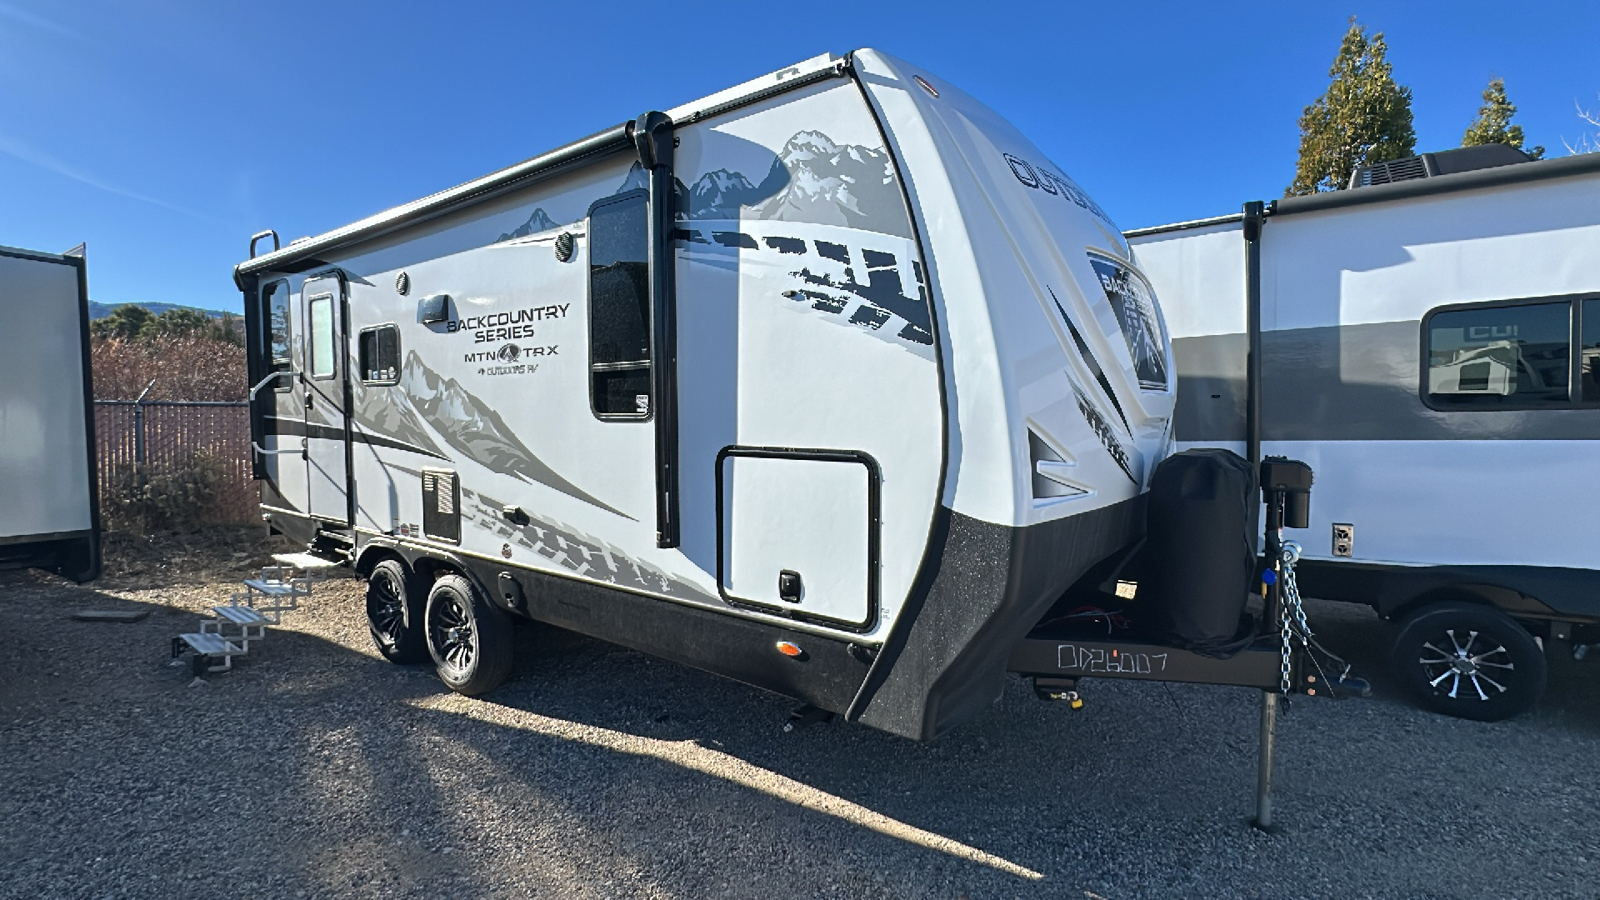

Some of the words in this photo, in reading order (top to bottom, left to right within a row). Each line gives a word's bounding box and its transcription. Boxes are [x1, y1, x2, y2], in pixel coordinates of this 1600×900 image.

[447, 303, 570, 333] BACKCOUNTRY
[475, 324, 534, 343] SERIES
[464, 351, 496, 363] MTN
[523, 345, 559, 357] TRX
[487, 364, 526, 376] OUTDOORS
[527, 363, 539, 374] RV
